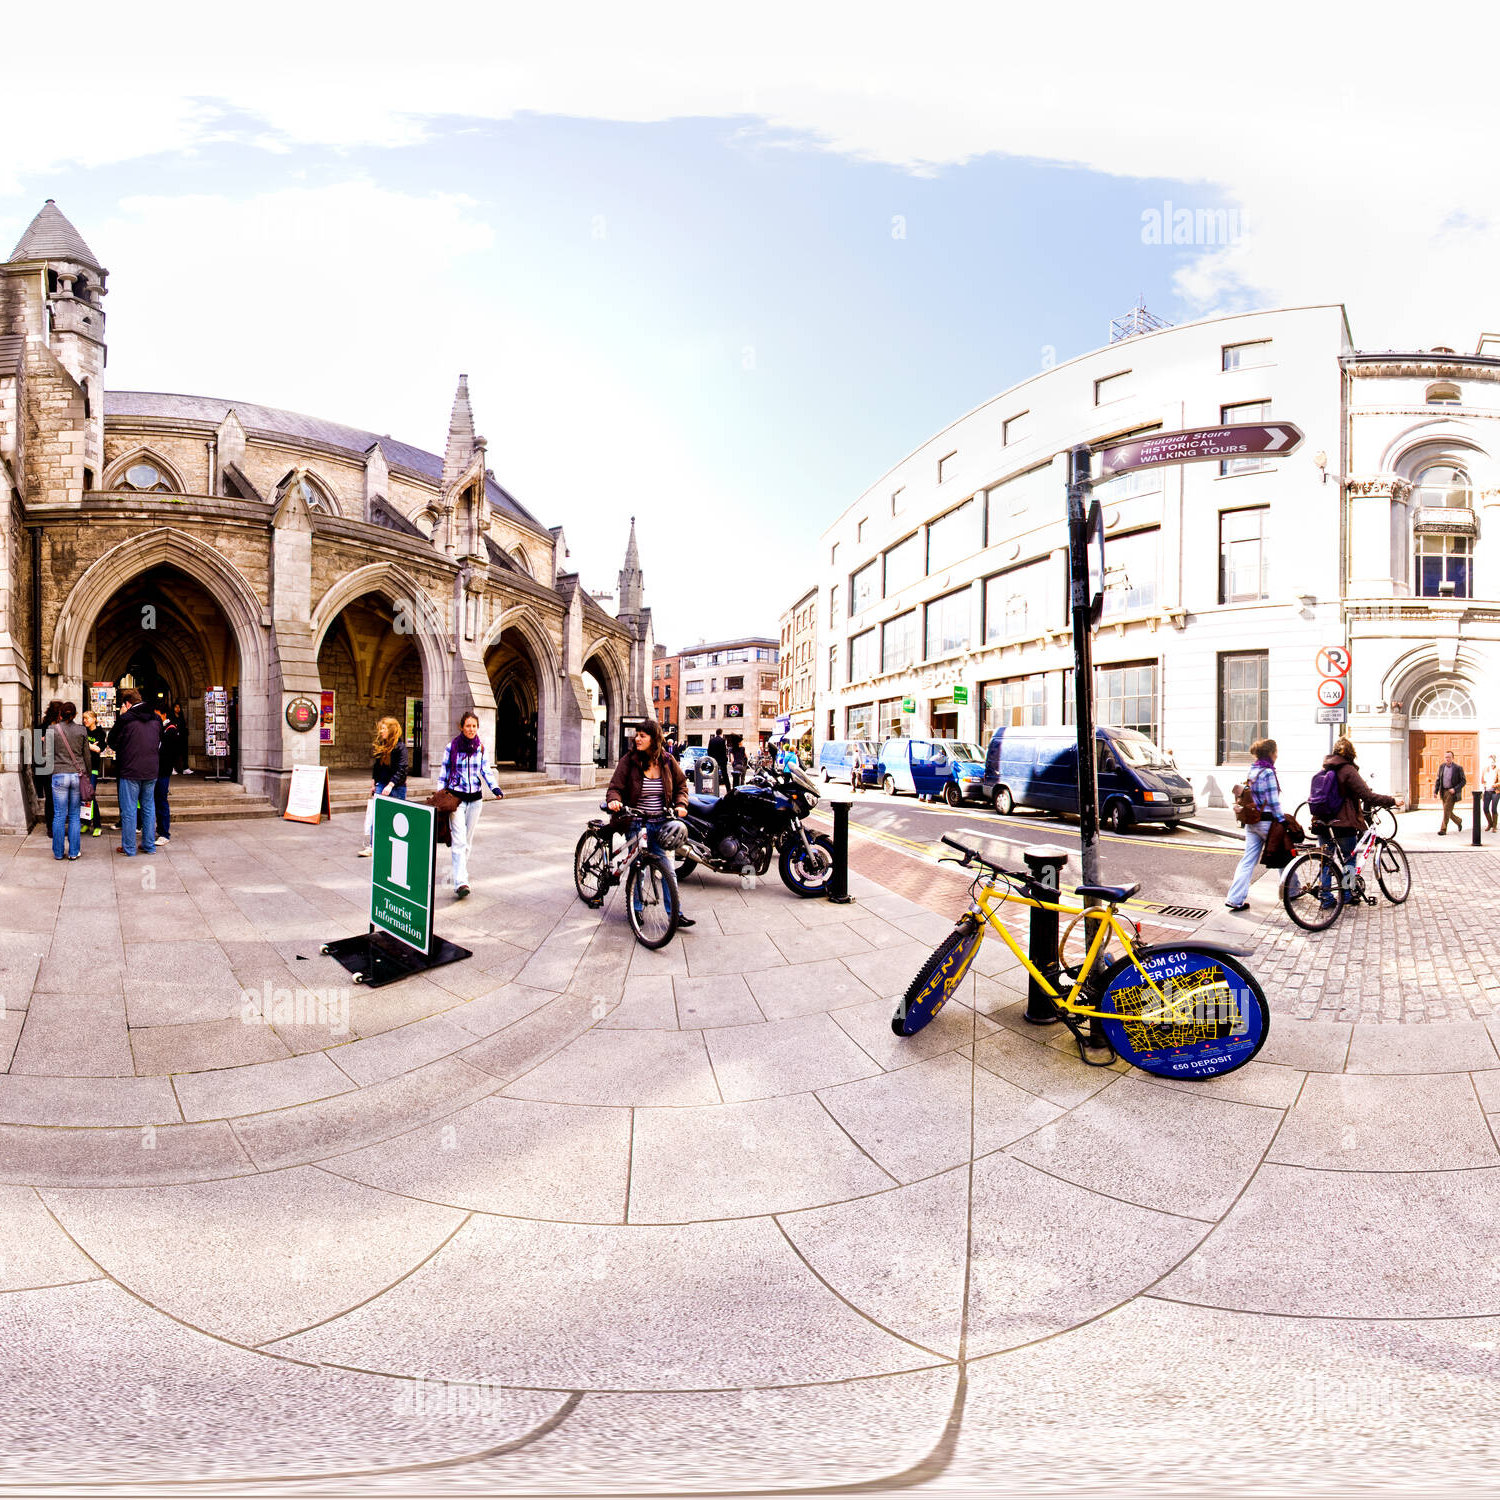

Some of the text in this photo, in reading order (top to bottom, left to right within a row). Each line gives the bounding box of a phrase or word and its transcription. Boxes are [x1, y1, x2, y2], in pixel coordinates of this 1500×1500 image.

[1192, 431, 1232, 440] Staire
[1140, 439, 1216, 456] HISTORICAL
[1140, 444, 1248, 463] WALKING TOURS
[1328, 651, 1341, 672] P
[384, 897, 412, 922] Tourist
[375, 906, 422, 940] Information
[916, 938, 966, 1005] RENT
[1134, 952, 1187, 972] FROM €10
[1140, 963, 1188, 984] PER DAY
[1172, 1063, 1189, 1071] €50
[1190, 1055, 1232, 1068] DEPOSIT
[1202, 1066, 1219, 1074] I.D.
